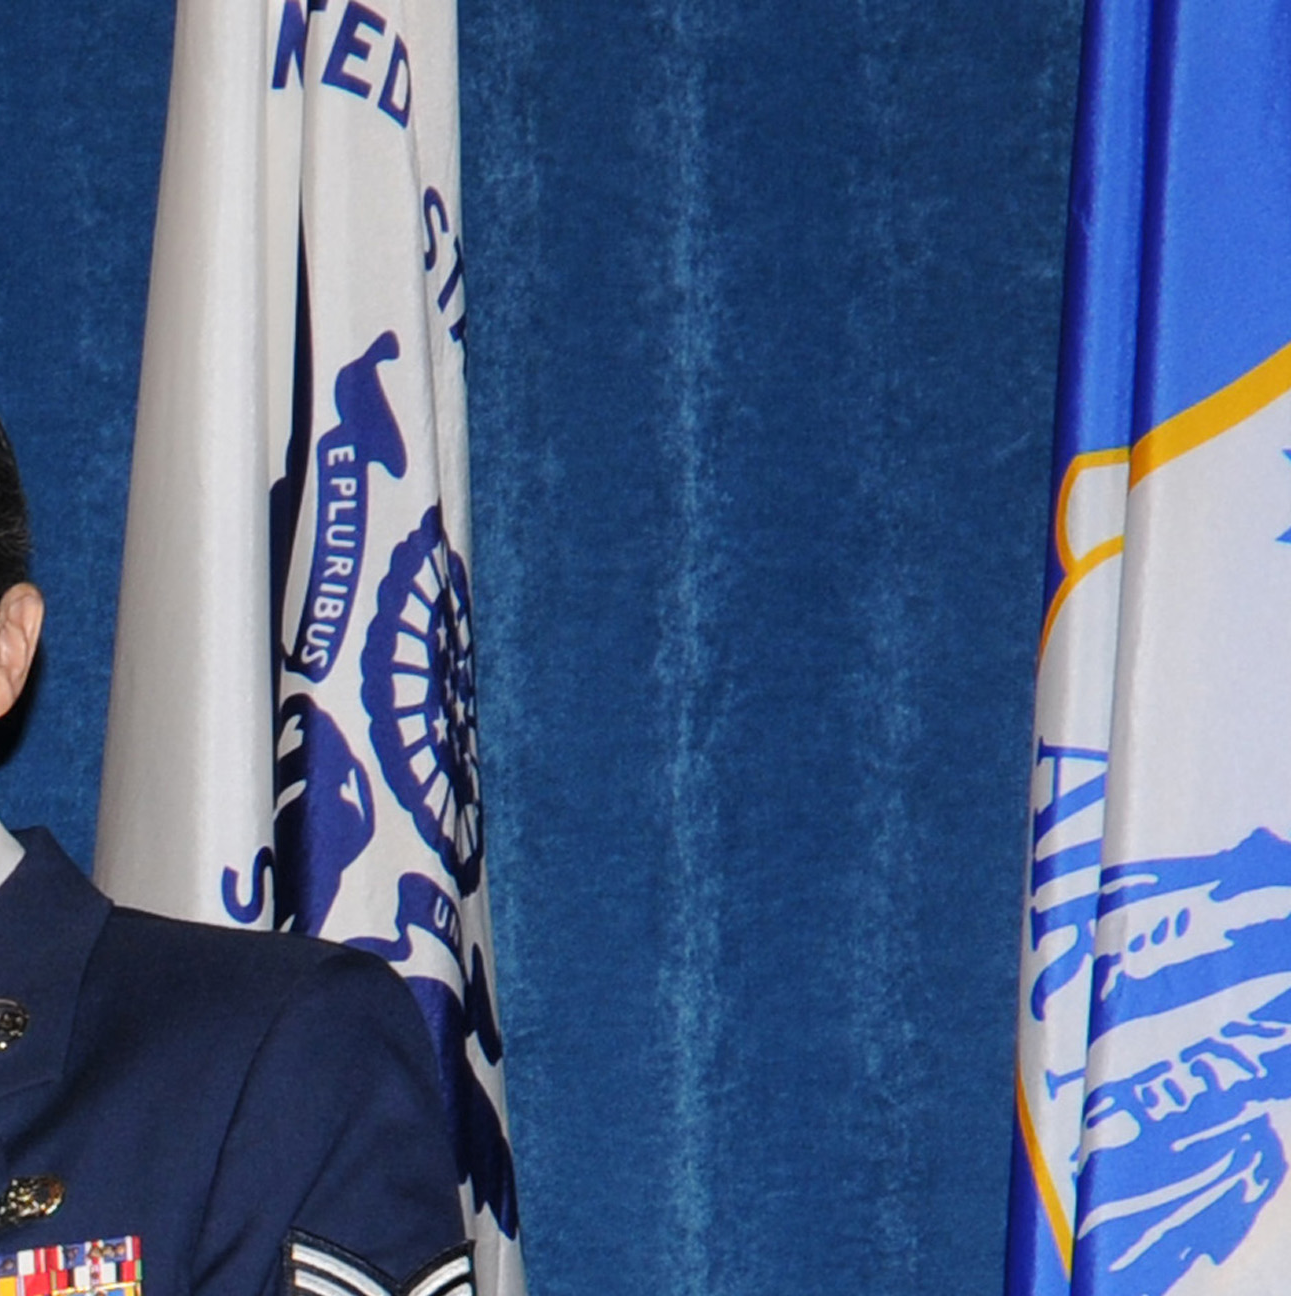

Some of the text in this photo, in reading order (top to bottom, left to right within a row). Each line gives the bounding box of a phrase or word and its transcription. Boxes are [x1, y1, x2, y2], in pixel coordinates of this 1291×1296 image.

[272, 0, 411, 129] NED
[301, 445, 357, 668] E PLURIBUS
